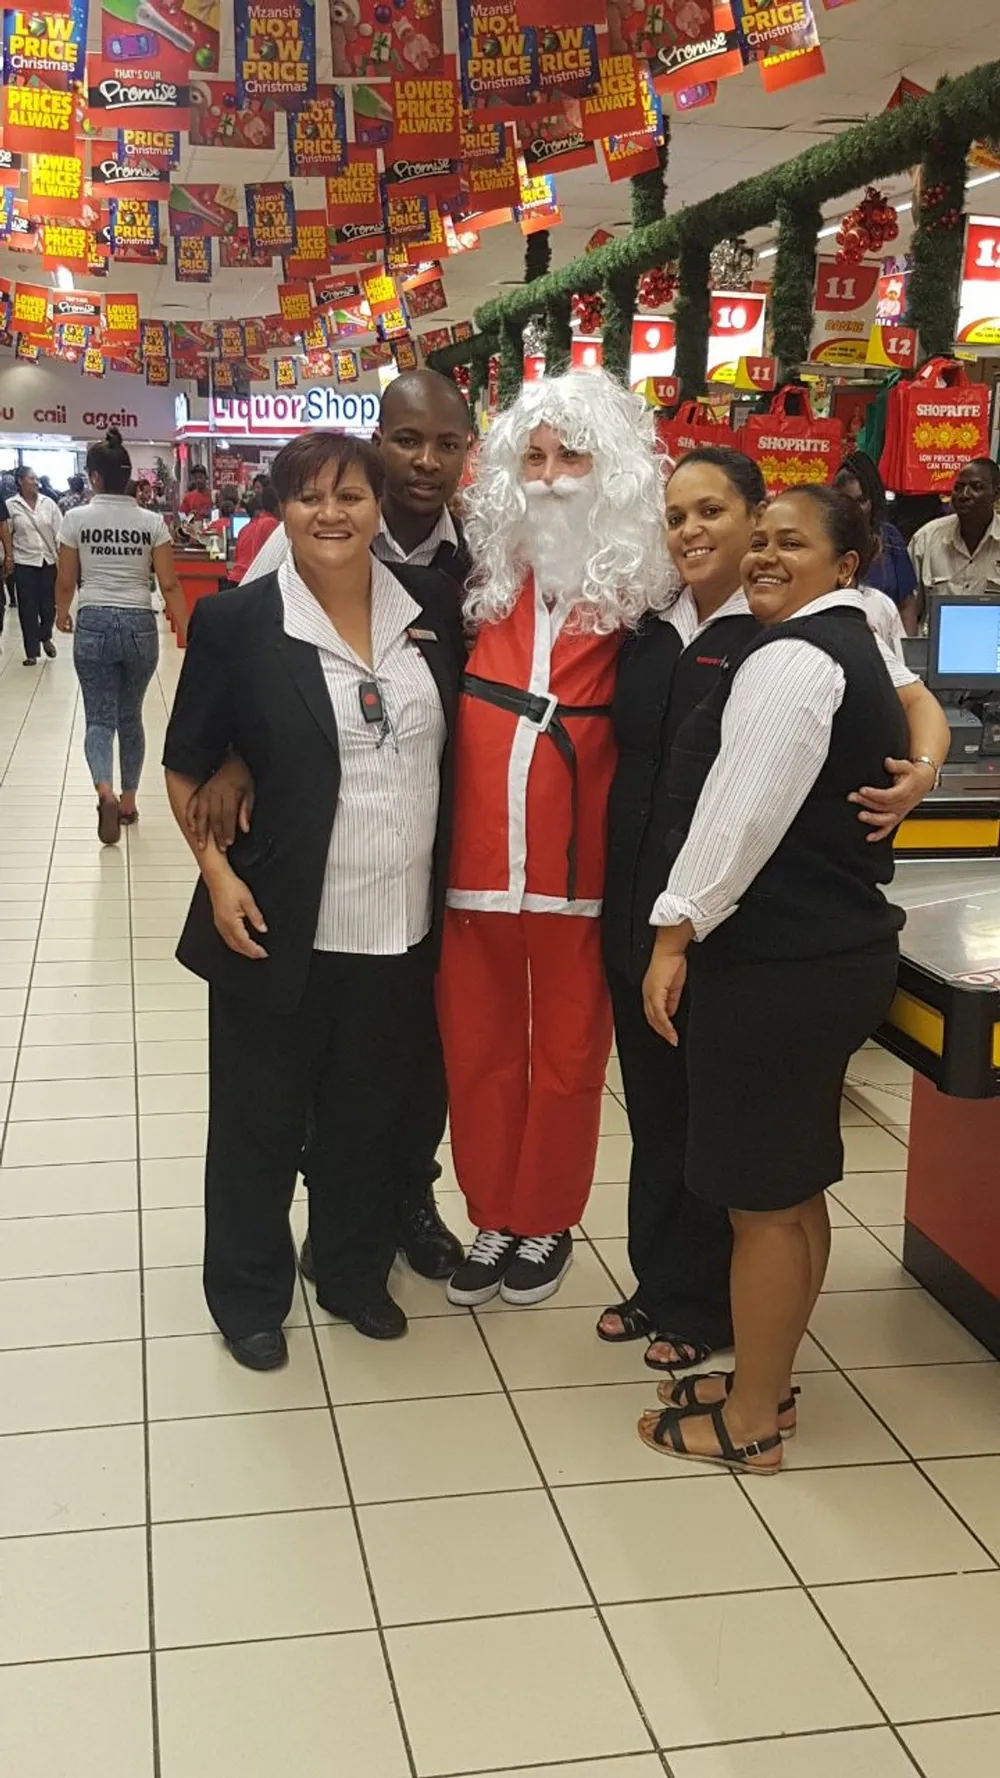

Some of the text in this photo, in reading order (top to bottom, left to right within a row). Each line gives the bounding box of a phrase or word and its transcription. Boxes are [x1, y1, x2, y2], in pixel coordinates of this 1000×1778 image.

[248, 5, 302, 19] Mzansi's
[470, 2, 516, 17] Mzansi'
[741, 2, 806, 35] PRICE
[747, 19, 808, 45] Christmas
[9, 35, 78, 63] PRICE
[11, 55, 75, 72] Christmas
[468, 56, 532, 79] PRICE
[538, 48, 592, 73] RICE
[600, 55, 634, 77] WER
[114, 68, 161, 80] THAT'S OUR
[242, 62, 309, 81] PRICE
[540, 67, 592, 86] hristmas
[99, 79, 178, 102] Promise
[245, 81, 308, 94] Christmas
[395, 80, 454, 99] LOWER
[470, 76, 531, 92] Christmas
[601, 73, 636, 97] ICES
[8, 89, 72, 115] PRICES
[396, 98, 455, 118] PRICES
[584, 92, 636, 114] ALWAYS
[8, 110, 70, 131] ALWAYS
[399, 118, 453, 134] ALWAYS
[124, 129, 175, 148] PRICE
[293, 139, 342, 155] PRICE
[531, 133, 585, 157] Promise
[125, 144, 174, 156] Christmas
[295, 152, 342, 164] Christmas
[29, 153, 82, 172] LOWER
[344, 163, 375, 178] WER
[393, 158, 451, 178] Promise
[31, 168, 82, 188] PRICES
[328, 177, 376, 193] PRICES
[473, 176, 515, 193] ALWAYS
[32, 183, 80, 200] ALWAYS
[330, 191, 374, 205] ALWAYS
[521, 183, 553, 204] RICE
[388, 211, 426, 228] PRICE
[114, 225, 155, 239] PRICE
[253, 226, 292, 240] PRICE
[296, 226, 326, 238] WER
[342, 221, 385, 238] Promis
[45, 233, 86, 247] PRICES
[115, 236, 154, 245] Christmas
[45, 245, 85, 258] ALWAYS
[975, 240, 1000, 269] 1
[178, 258, 209, 269] PRICE
[824, 277, 856, 300] 11
[107, 304, 137, 315] LOWER
[108, 313, 137, 322] PRICES
[716, 307, 747, 328] 10
[645, 328, 661, 348] 9
[887, 337, 911, 355] 12
[751, 366, 771, 381] 11
[658, 384, 675, 397] 10
[82, 408, 138, 430] again
[916, 403, 981, 418] SHOPRITE
[758, 435, 831, 453] SHOPRITE
[919, 454, 932, 462] LOW
[934, 454, 955, 462] PRICES
[926, 462, 961, 470] CAN TRUST
[80, 529, 151, 546] HORISON
[90, 546, 143, 556] TROLLEYS
